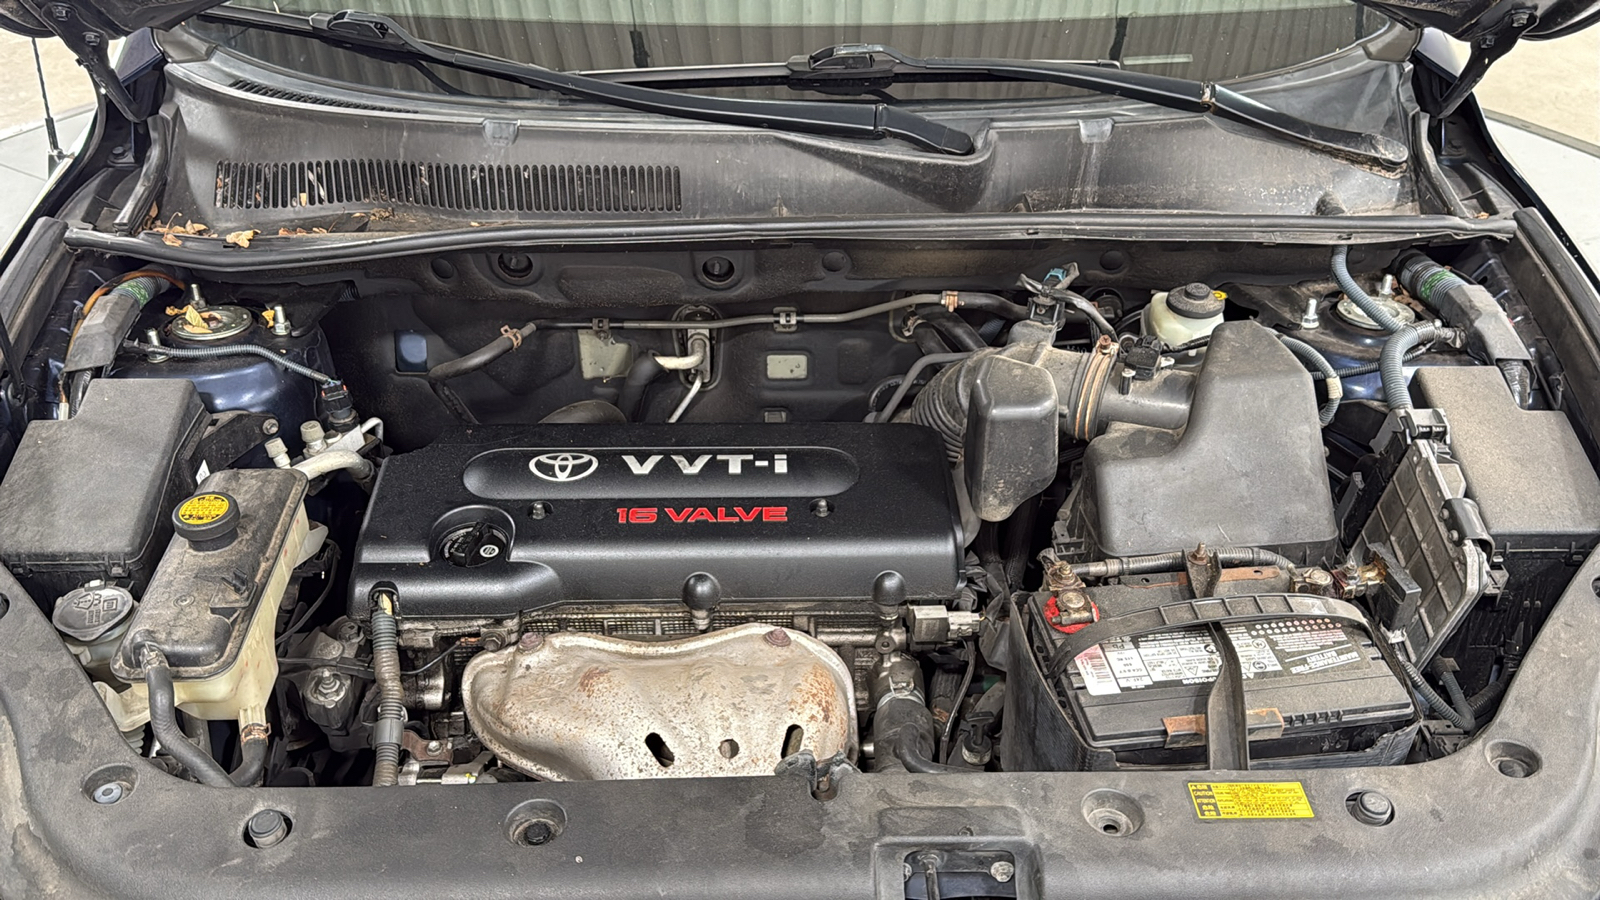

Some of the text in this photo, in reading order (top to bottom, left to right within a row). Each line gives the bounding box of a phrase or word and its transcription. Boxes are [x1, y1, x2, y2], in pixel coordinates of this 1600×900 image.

[621, 454, 788, 475] VVT-i
[616, 506, 788, 524] 16 VALVE
